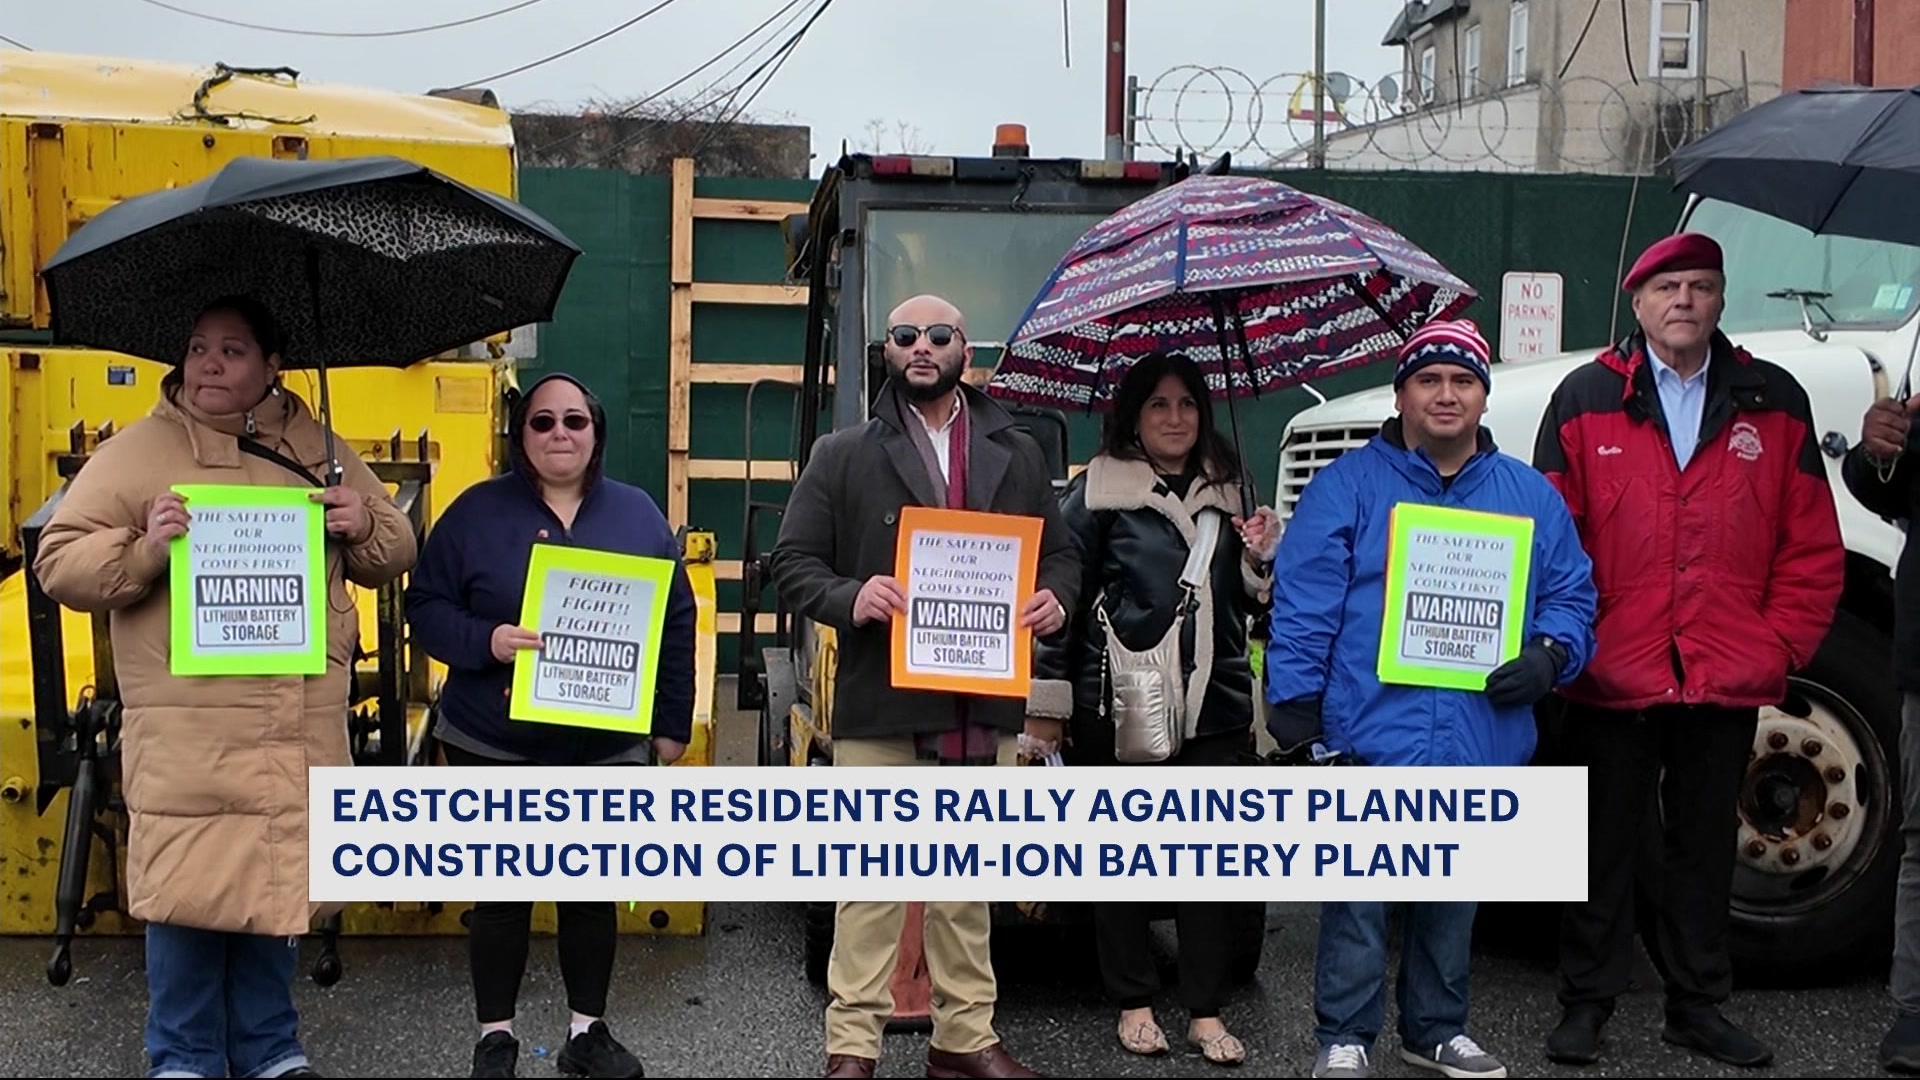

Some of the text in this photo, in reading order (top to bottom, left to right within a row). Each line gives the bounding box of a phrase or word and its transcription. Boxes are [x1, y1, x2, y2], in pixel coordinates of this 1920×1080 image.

[1521, 283, 1543, 299] NO
[1508, 303, 1555, 321] PARKING
[1520, 327, 1541, 337] ANY
[1518, 342, 1544, 354] TIME
[197, 513, 221, 522] THE
[227, 513, 277, 523] SAFETY
[234, 528, 263, 538] OUR
[1416, 534, 1438, 544] THE
[1444, 536, 1488, 548] SAFETY
[919, 537, 943, 547] THE
[946, 539, 993, 551] SAFETY
[201, 559, 248, 569] COMES
[950, 555, 978, 565] OUR
[1446, 552, 1473, 563] OUR
[201, 577, 299, 603] WARNING
[568, 577, 630, 596] FIGHT!
[918, 583, 963, 595] COMES
[1414, 578, 1458, 590] COMES
[561, 596, 630, 616] FIGHT!!
[1412, 594, 1498, 626] WARNING
[203, 609, 297, 623] LITHIUM BATTERY
[917, 601, 1005, 630] WARNING
[222, 624, 279, 641] STORAGE
[555, 616, 630, 636] FIGHT!!!
[1410, 623, 1495, 644] LITHIUM BATTERY
[917, 632, 1001, 649] LITHIUM BATTERY
[545, 635, 635, 669] WARNING
[933, 648, 986, 665] STORAGE
[1424, 640, 1477, 659] STORAGE
[543, 665, 630, 687] LITHIUM BATTERY
[558, 682, 611, 702] STORAGE
